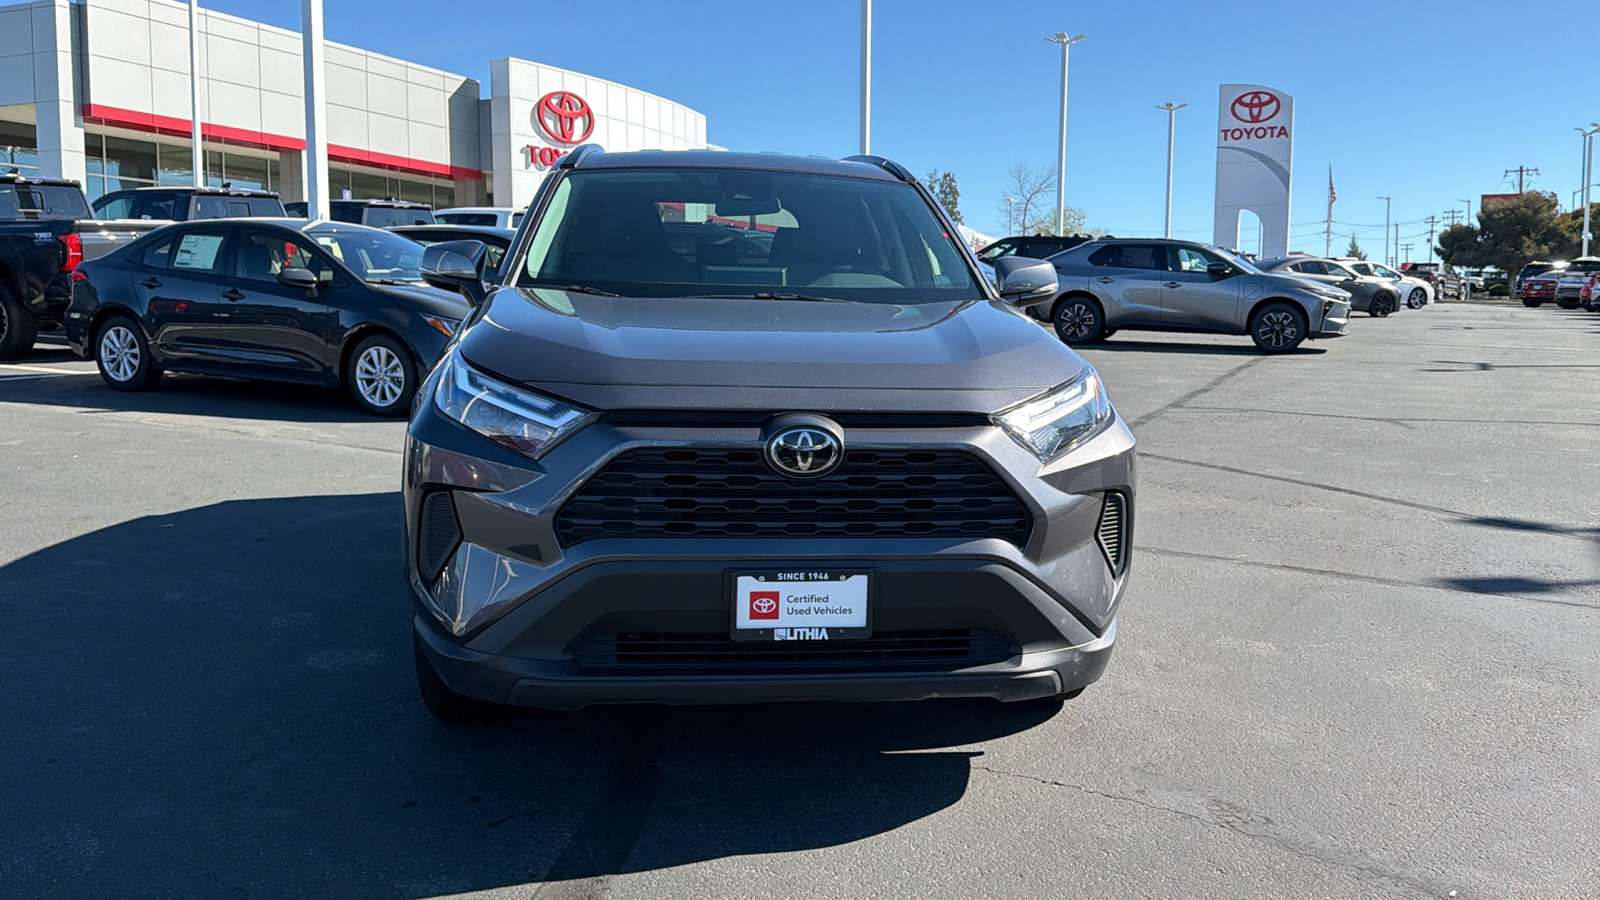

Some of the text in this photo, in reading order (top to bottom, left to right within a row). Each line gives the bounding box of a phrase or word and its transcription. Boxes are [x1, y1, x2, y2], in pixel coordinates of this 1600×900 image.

[1220, 125, 1289, 141] TOYOTA
[777, 572, 829, 581] SINCE 1946
[786, 594, 829, 604] Certified
[786, 606, 853, 616] Used Vehicles
[785, 627, 829, 640] LITHIA
